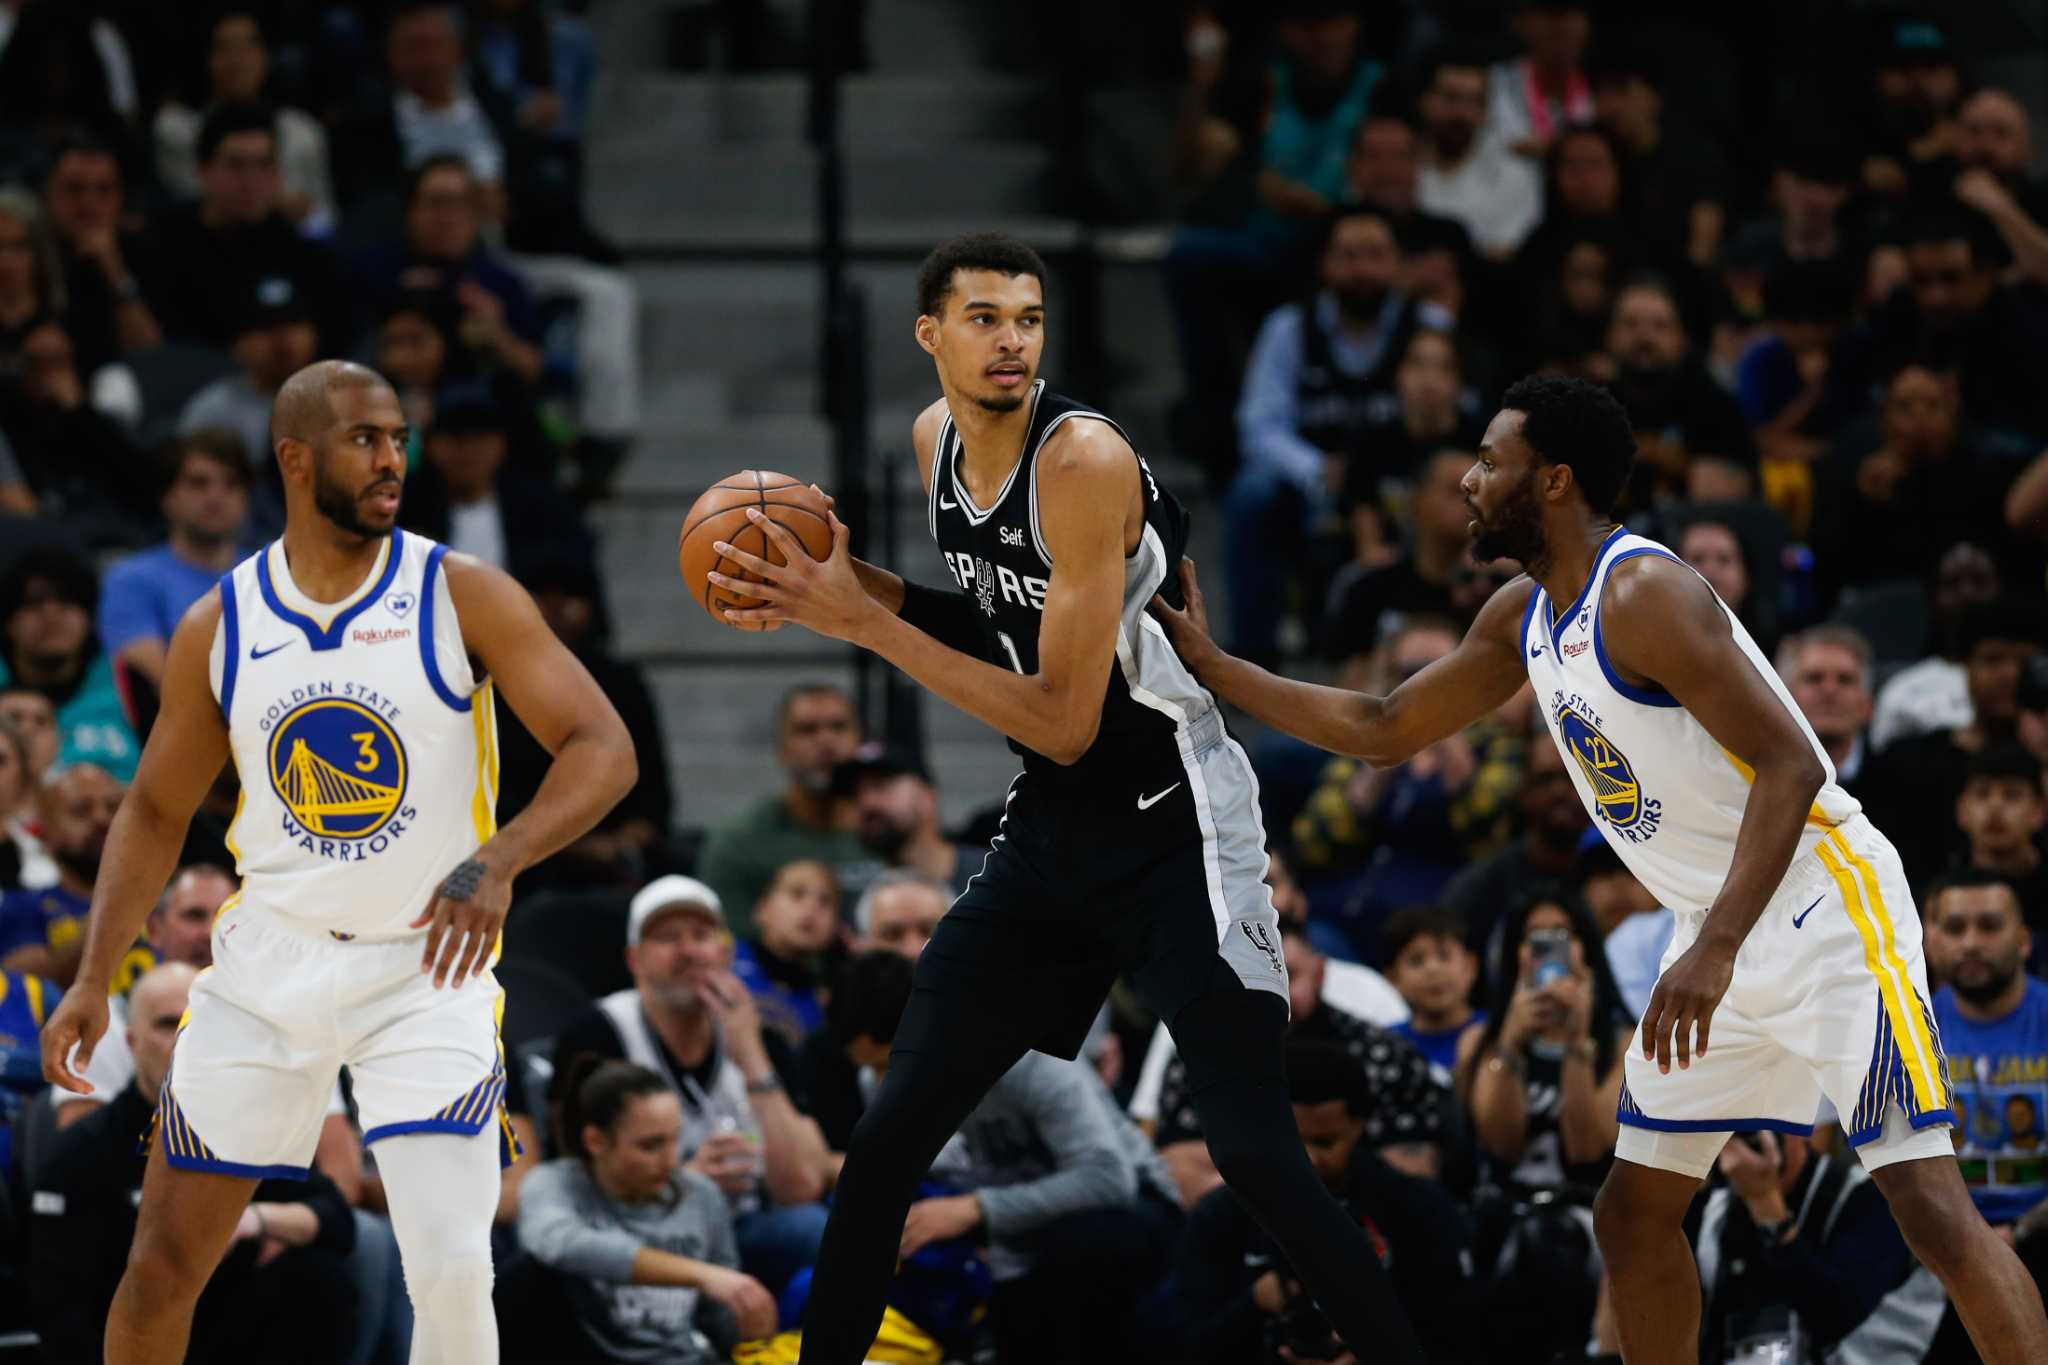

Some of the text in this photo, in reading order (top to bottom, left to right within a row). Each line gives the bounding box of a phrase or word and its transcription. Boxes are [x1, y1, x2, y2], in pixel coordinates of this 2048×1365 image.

[352, 628, 410, 645] Rakuten
[260, 681, 400, 732] GOLDEN STATE
[1567, 694, 1603, 728] STATE
[352, 732, 380, 773] 3
[1585, 736, 1619, 769] 22
[282, 806, 416, 861] WARRIORS
